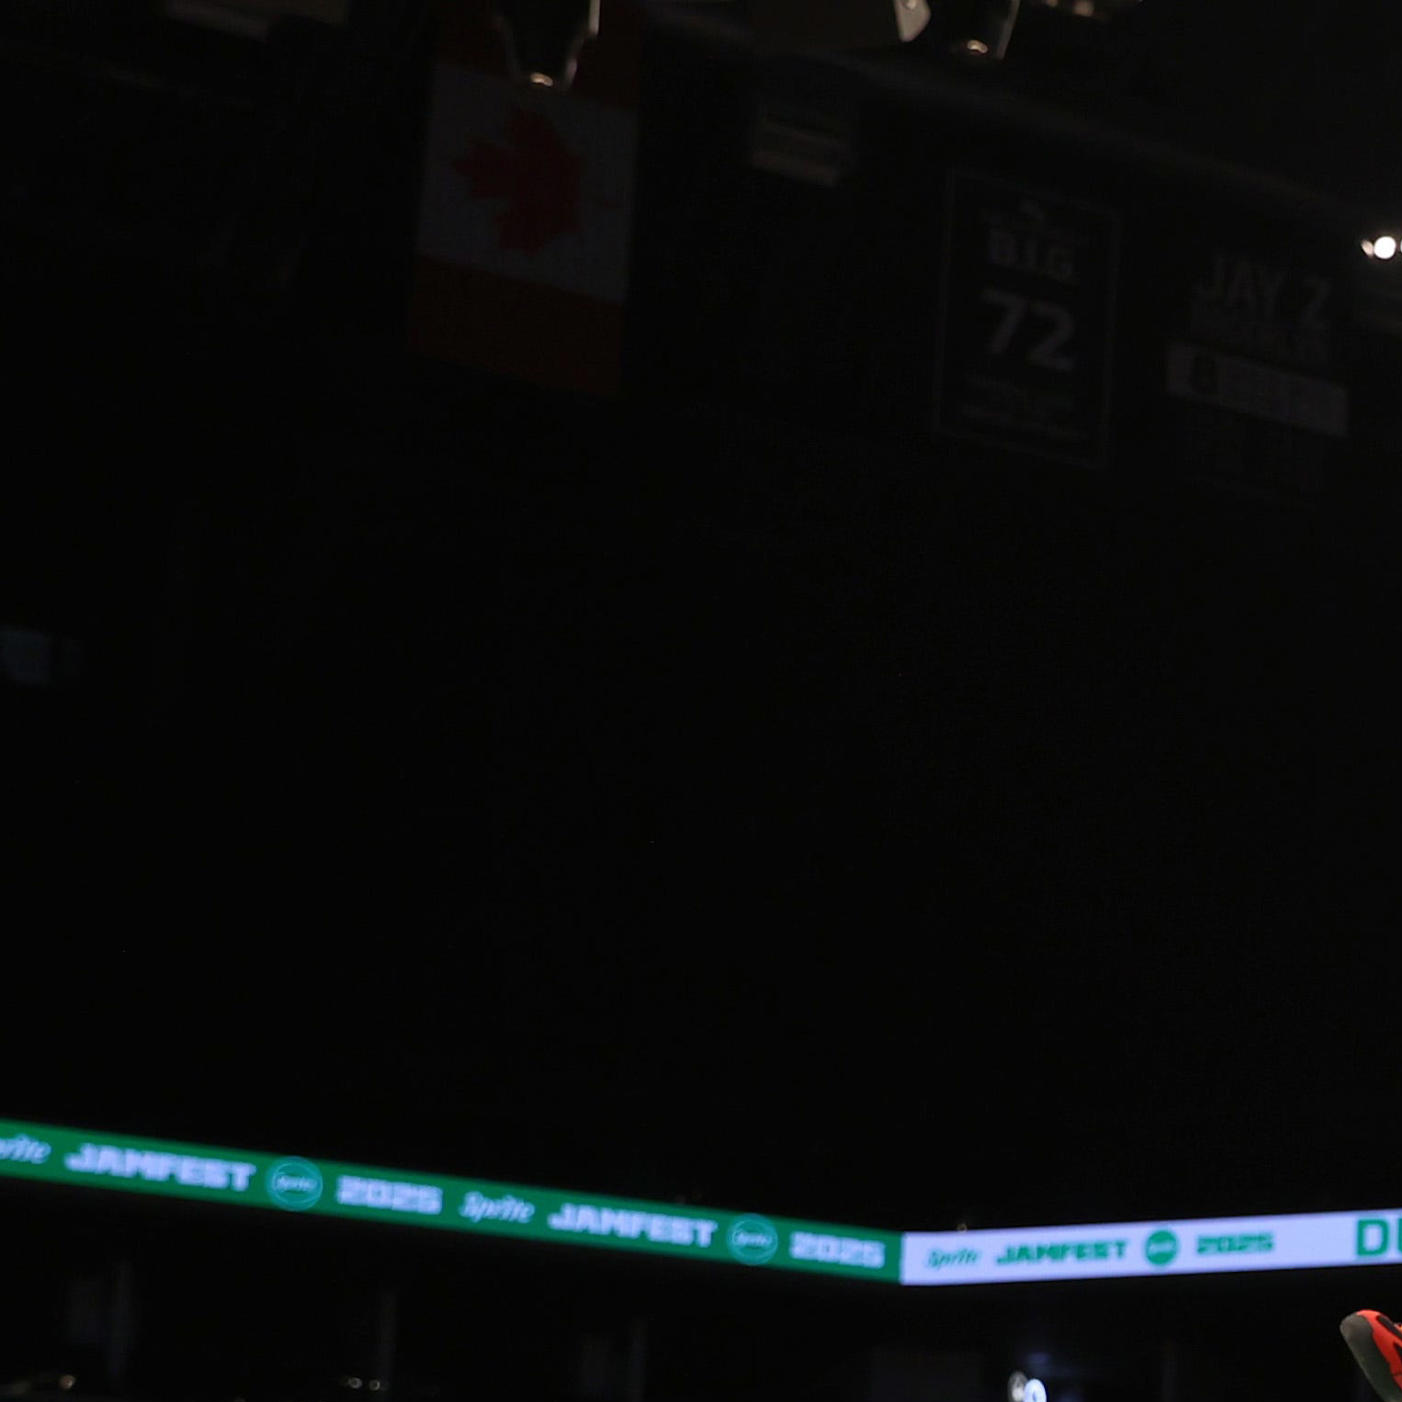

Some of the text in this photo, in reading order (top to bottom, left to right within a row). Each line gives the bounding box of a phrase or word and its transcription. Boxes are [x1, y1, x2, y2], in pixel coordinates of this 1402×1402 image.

[980, 287, 1076, 372] 72
[65, 1144, 256, 1191] JAMFEST
[336, 1175, 443, 1215] 2025
[459, 1191, 536, 1223] Sprite
[548, 1203, 717, 1247] JAMFEST
[788, 1231, 886, 1269] 2025
[995, 1239, 1128, 1266] JAMFEST
[1195, 1232, 1276, 1256] 2025
